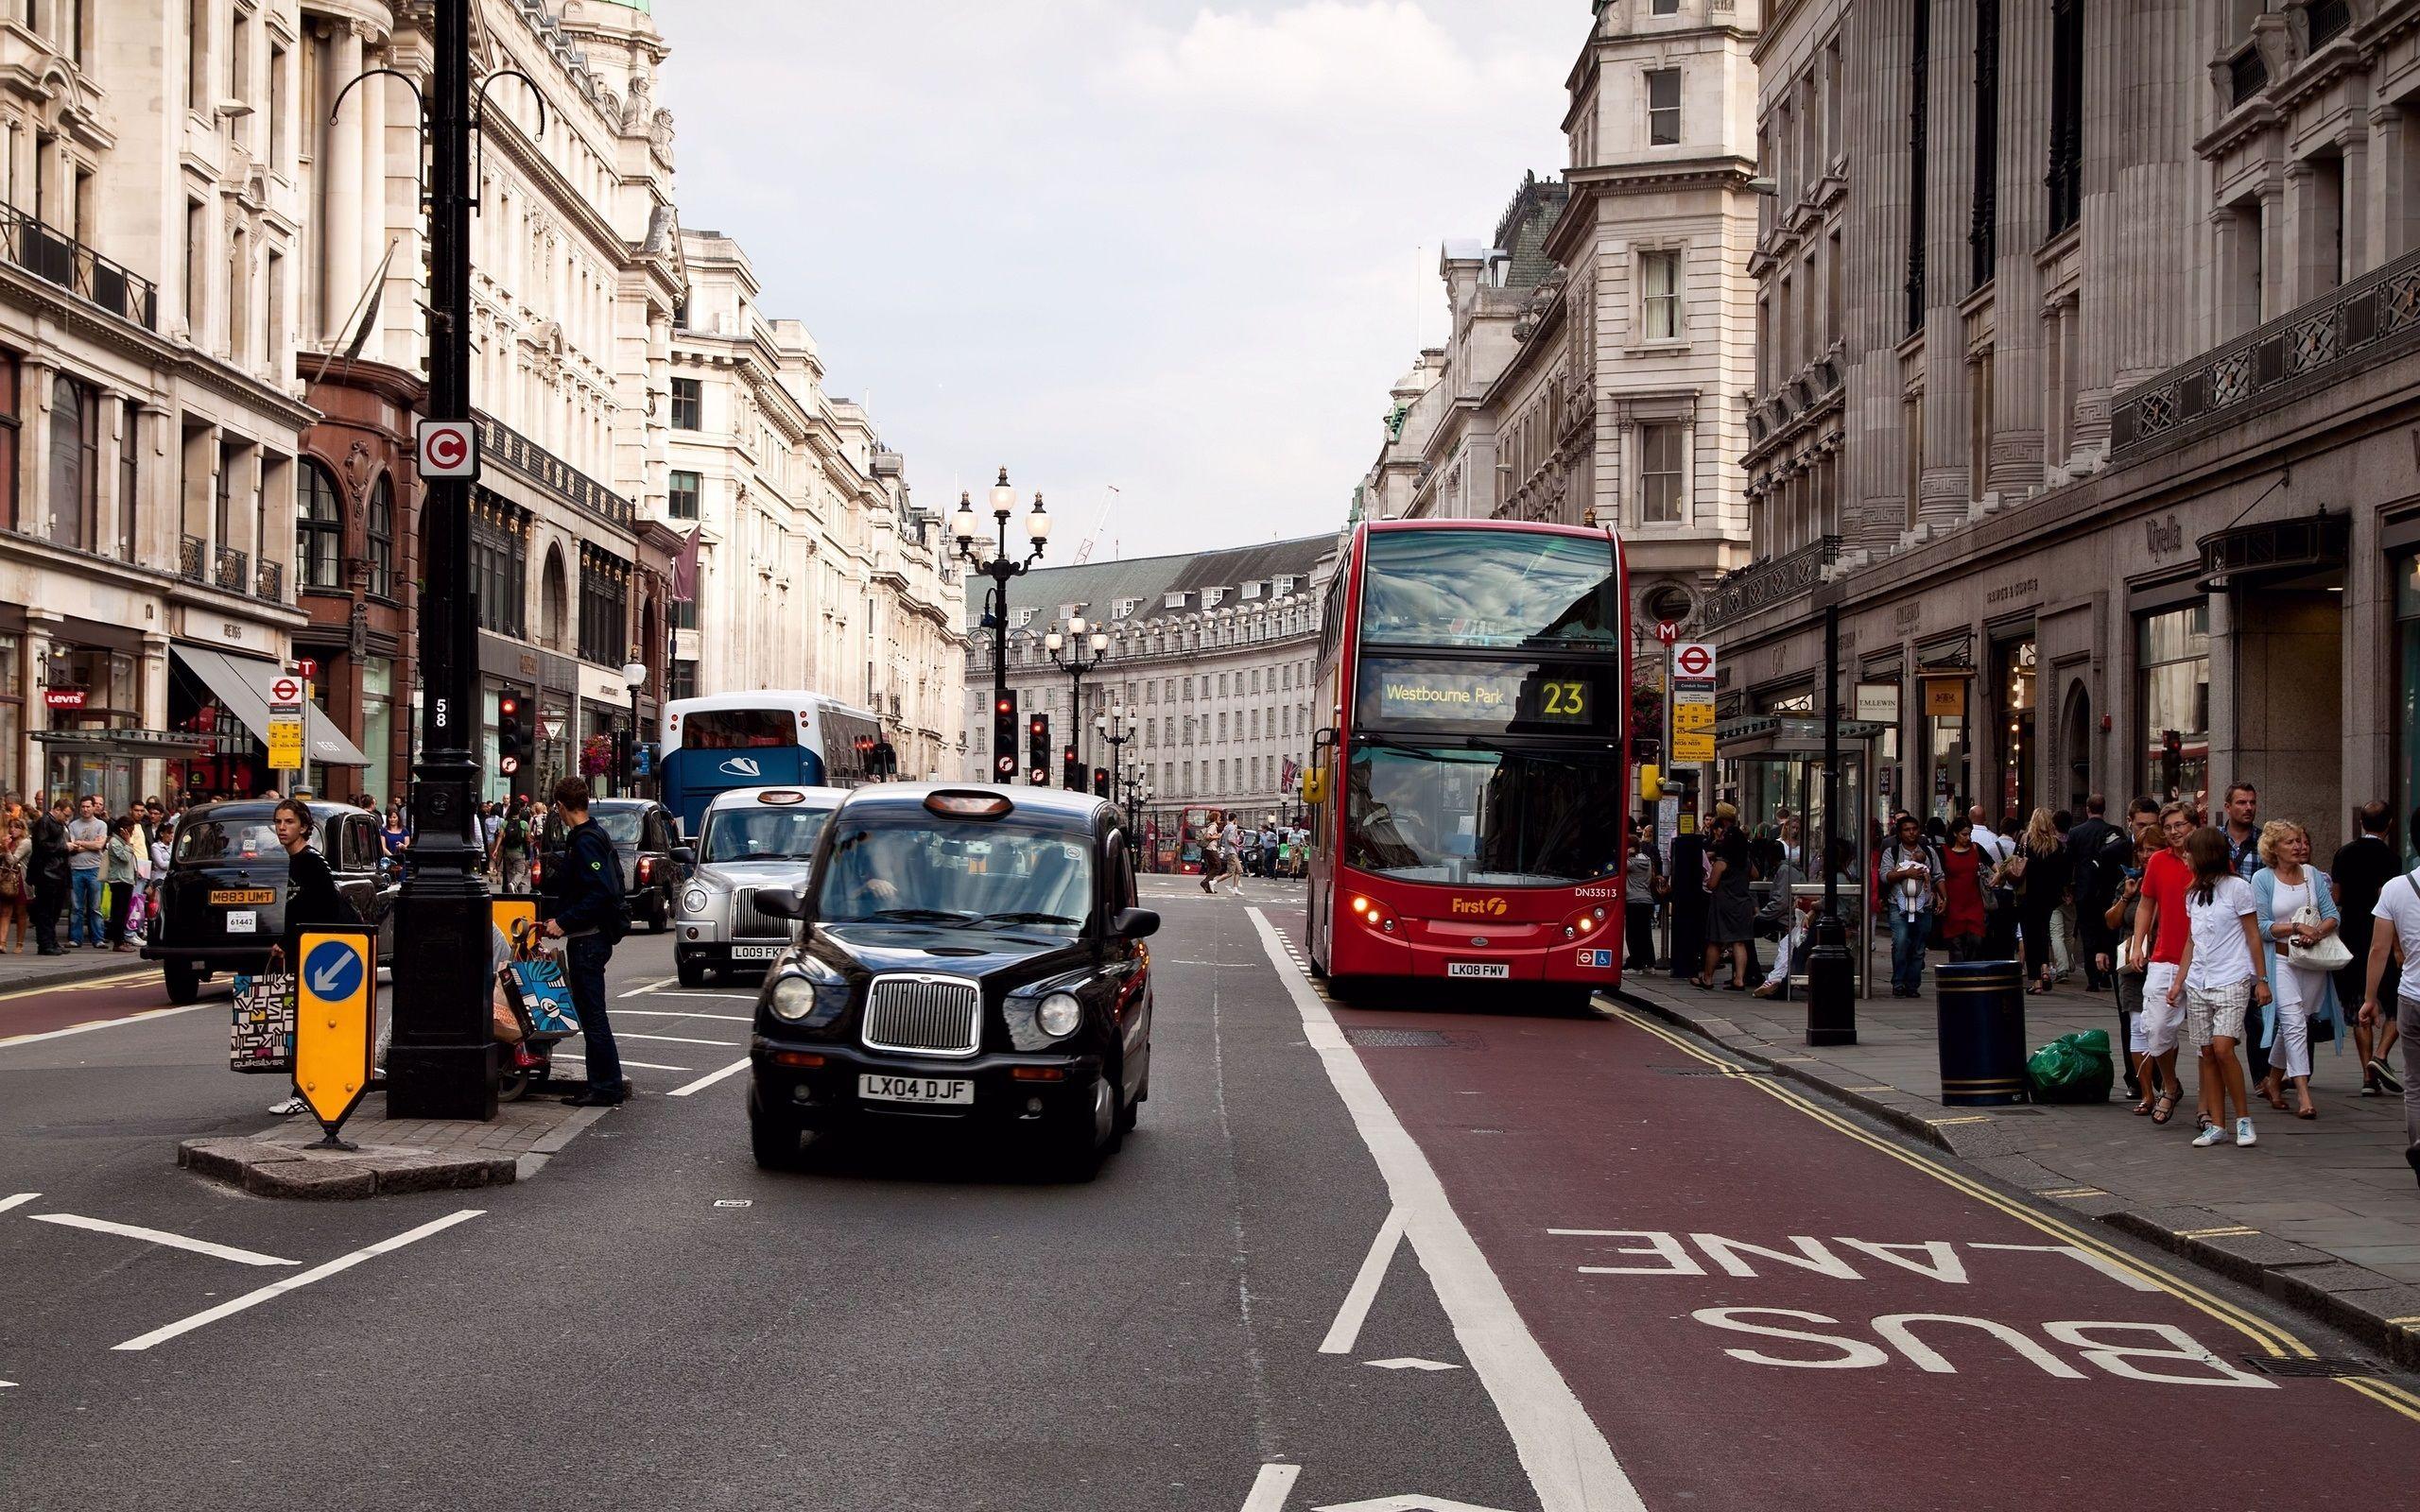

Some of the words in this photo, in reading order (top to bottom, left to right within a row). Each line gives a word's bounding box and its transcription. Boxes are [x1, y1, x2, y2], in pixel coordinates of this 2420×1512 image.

[1660, 625, 1676, 639] M
[302, 662, 313, 675] T
[1387, 683, 1469, 702] Westbourne
[1476, 687, 1503, 703] Park
[1543, 682, 1583, 713] 23
[213, 891, 245, 902] M883
[1575, 887, 1617, 898] DN33513
[1452, 898, 1485, 914] First
[766, 947, 785, 957] FK
[1452, 965, 1480, 975] LK08
[1483, 966, 1504, 976] FMV
[867, 1075, 919, 1097] LX04
[925, 1080, 965, 1099] DJF
[1547, 1228, 2169, 1293] LANE
[1690, 1306, 2282, 1388] BUS
